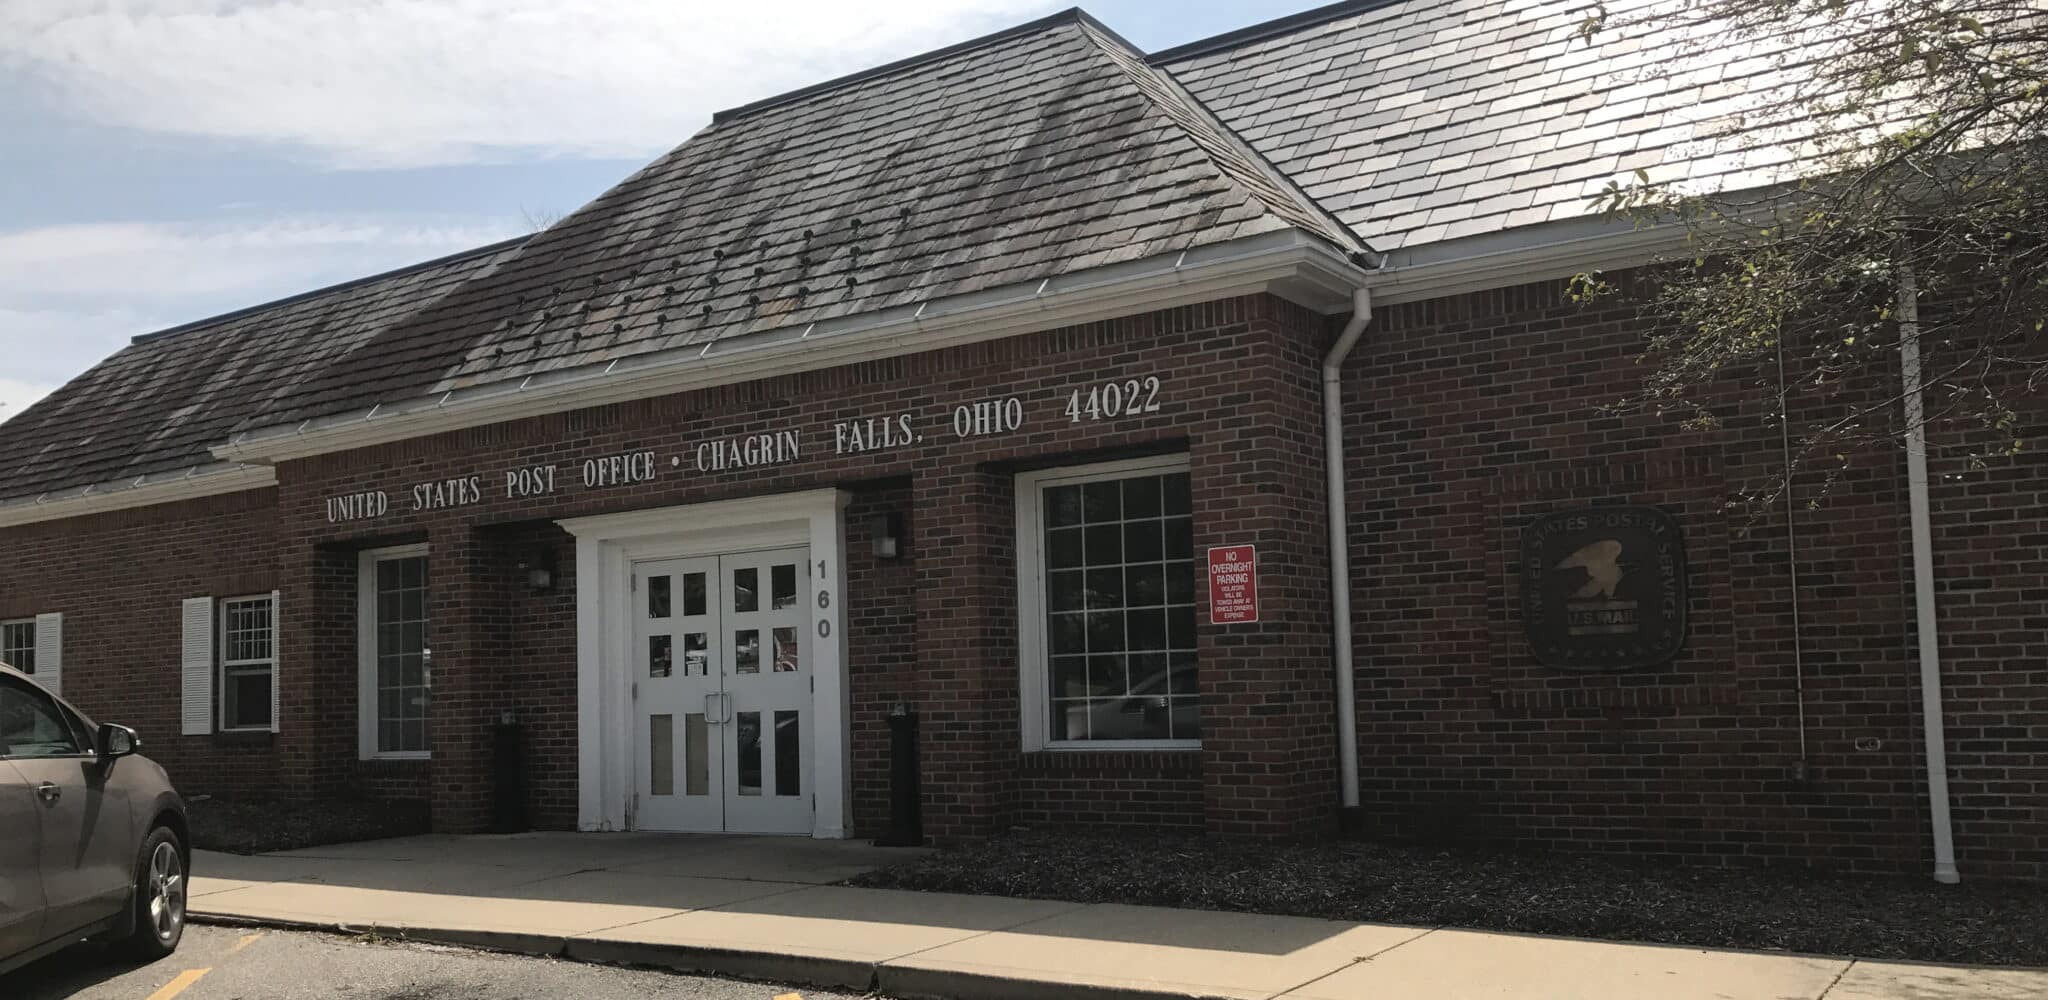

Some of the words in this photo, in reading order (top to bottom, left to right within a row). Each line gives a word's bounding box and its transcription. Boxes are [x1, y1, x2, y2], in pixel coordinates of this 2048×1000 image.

[327, 490, 388, 523] UNITED
[413, 475, 480, 511] STATES
[506, 464, 557, 499] POST
[583, 451, 656, 488] OFFICE
[696, 429, 800, 473] CHAGRIN
[953, 397, 1023, 438] OHIO
[1064, 376, 1161, 423] 44022
[1225, 551, 1237, 562] NO
[1211, 561, 1253, 574] OVERNIGHT
[1216, 573, 1249, 585] PARKING
